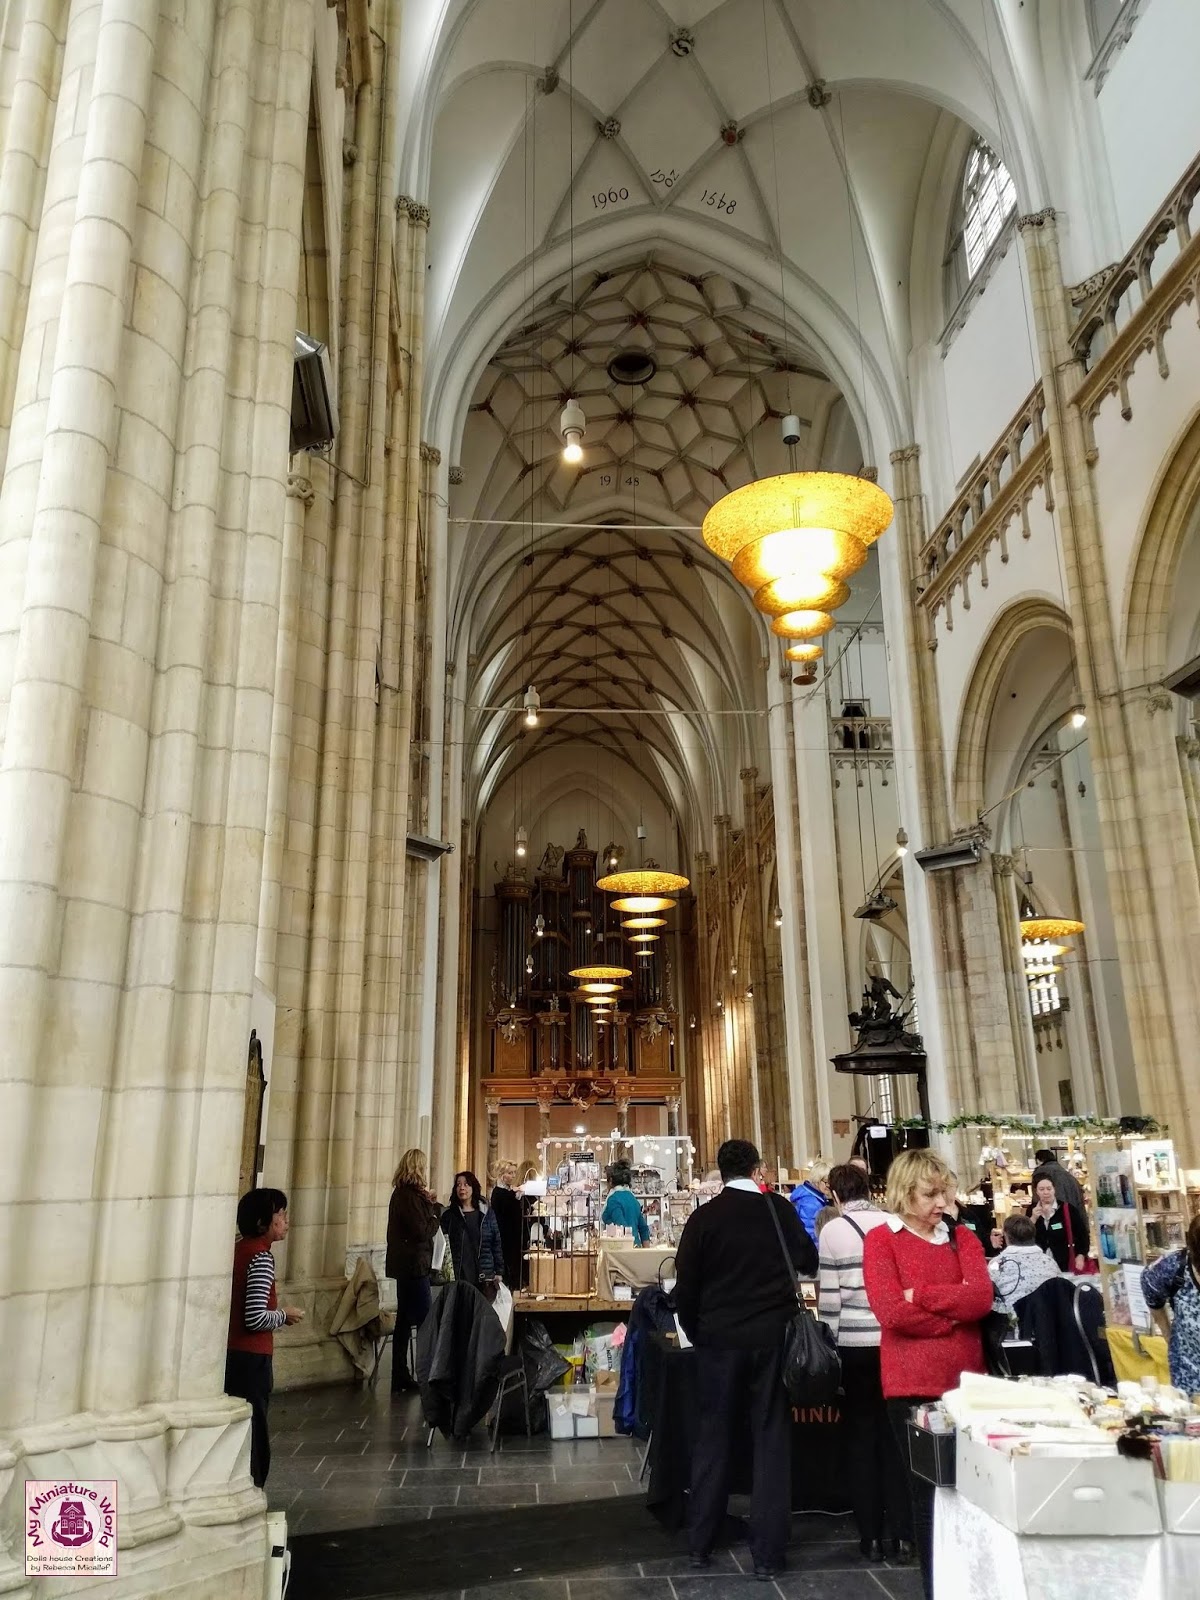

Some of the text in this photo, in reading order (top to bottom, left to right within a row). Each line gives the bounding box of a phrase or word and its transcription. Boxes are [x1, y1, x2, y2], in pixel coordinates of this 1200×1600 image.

[591, 187, 630, 210] 1960
[600, 475, 640, 487] 19 48
